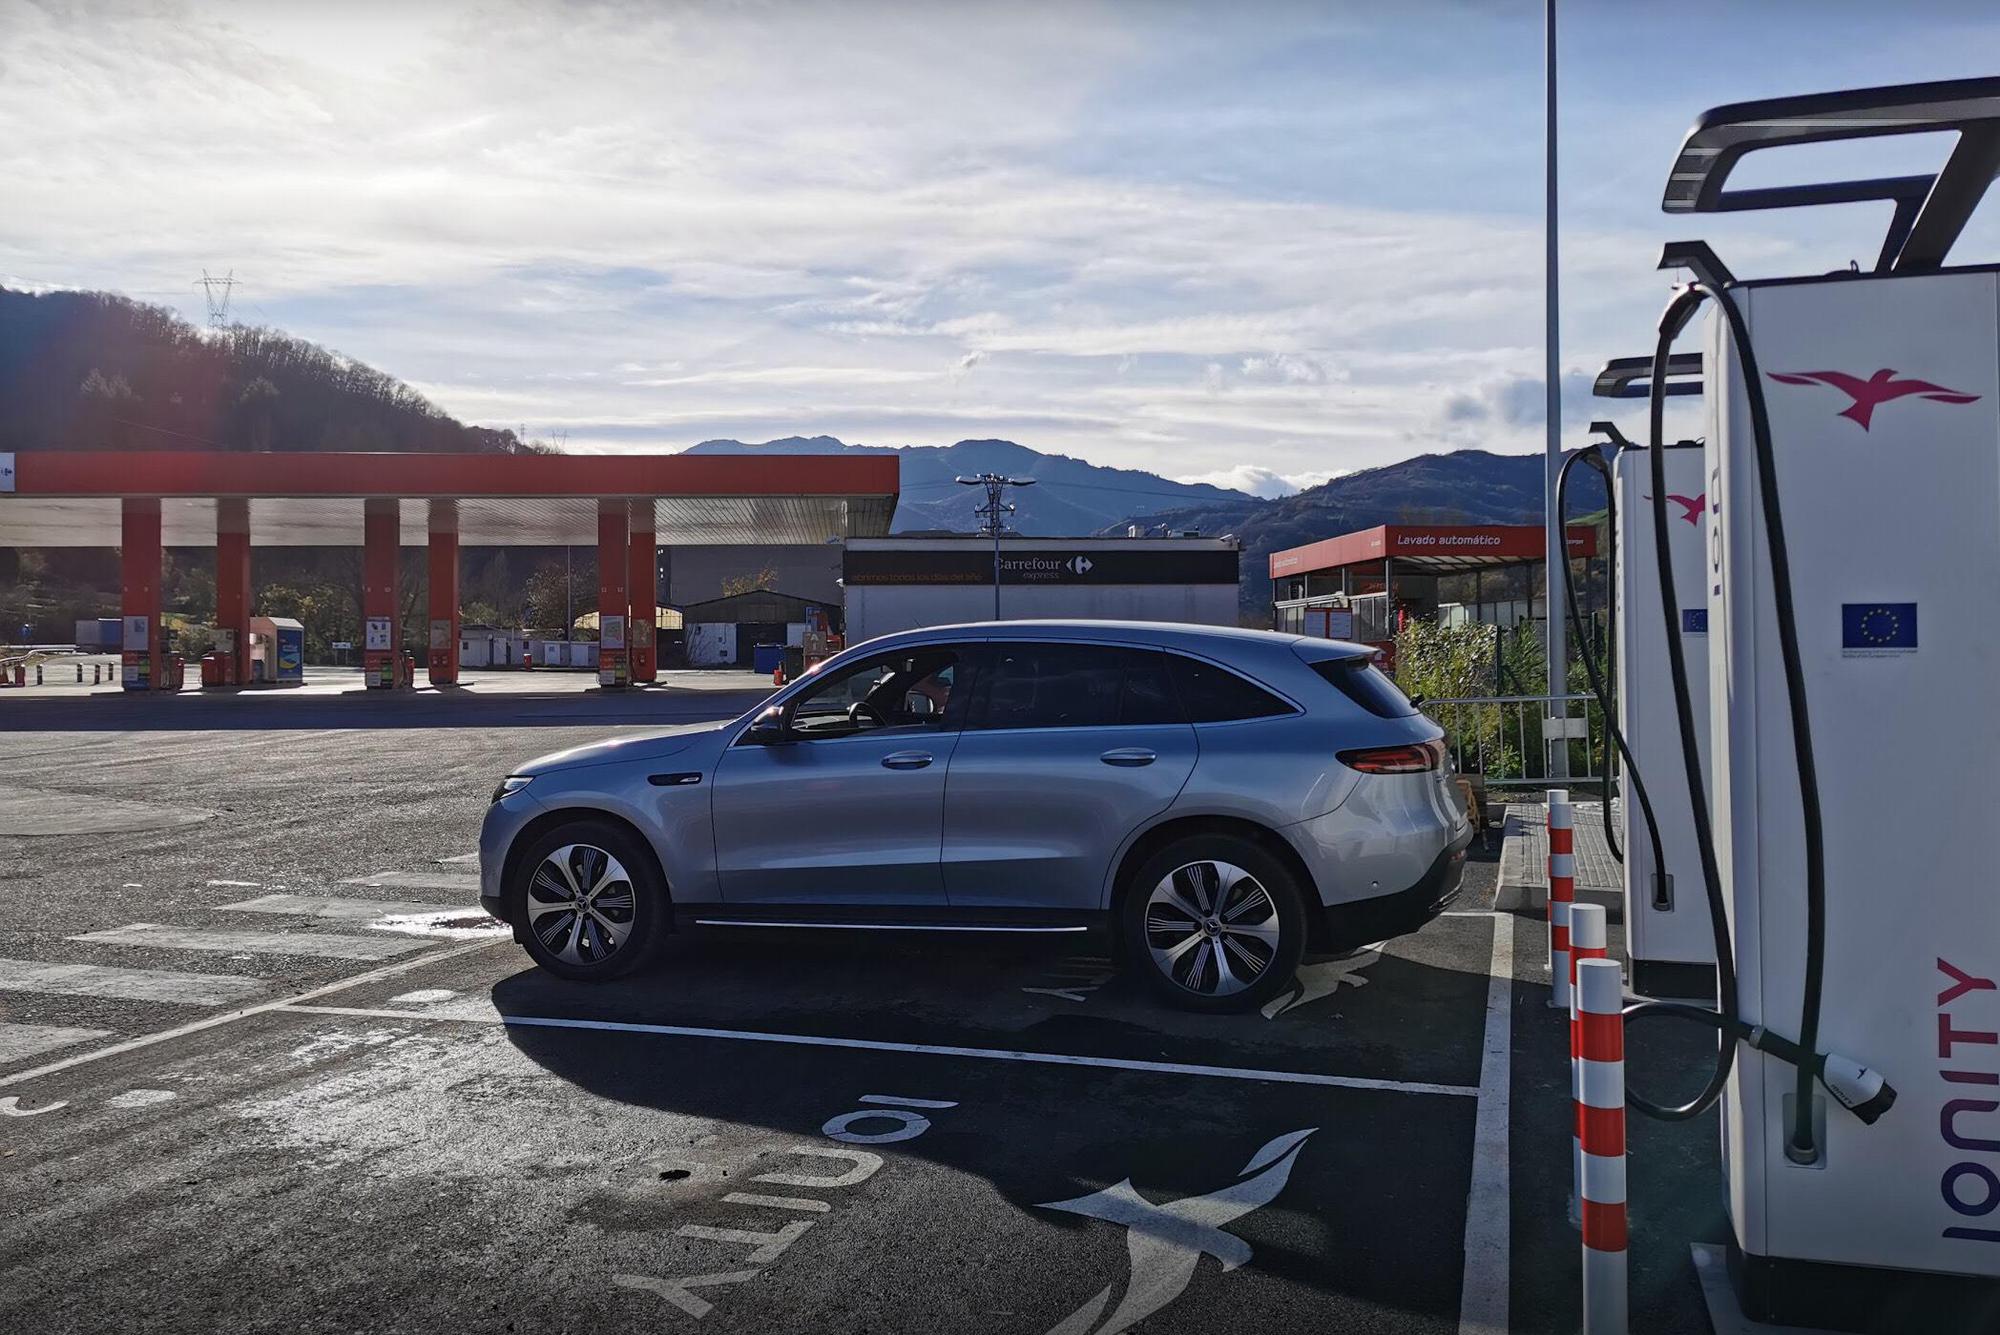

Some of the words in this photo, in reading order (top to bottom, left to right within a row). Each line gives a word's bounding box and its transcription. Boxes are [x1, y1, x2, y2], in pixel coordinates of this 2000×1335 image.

[1397, 534, 1436, 545] Lavado
[1438, 533, 1501, 546] automático
[994, 557, 1061, 570] Carrefour
[1022, 571, 1061, 581] express
[1936, 956, 2000, 1243] IONITY
[612, 1094, 959, 1320] IONITY
